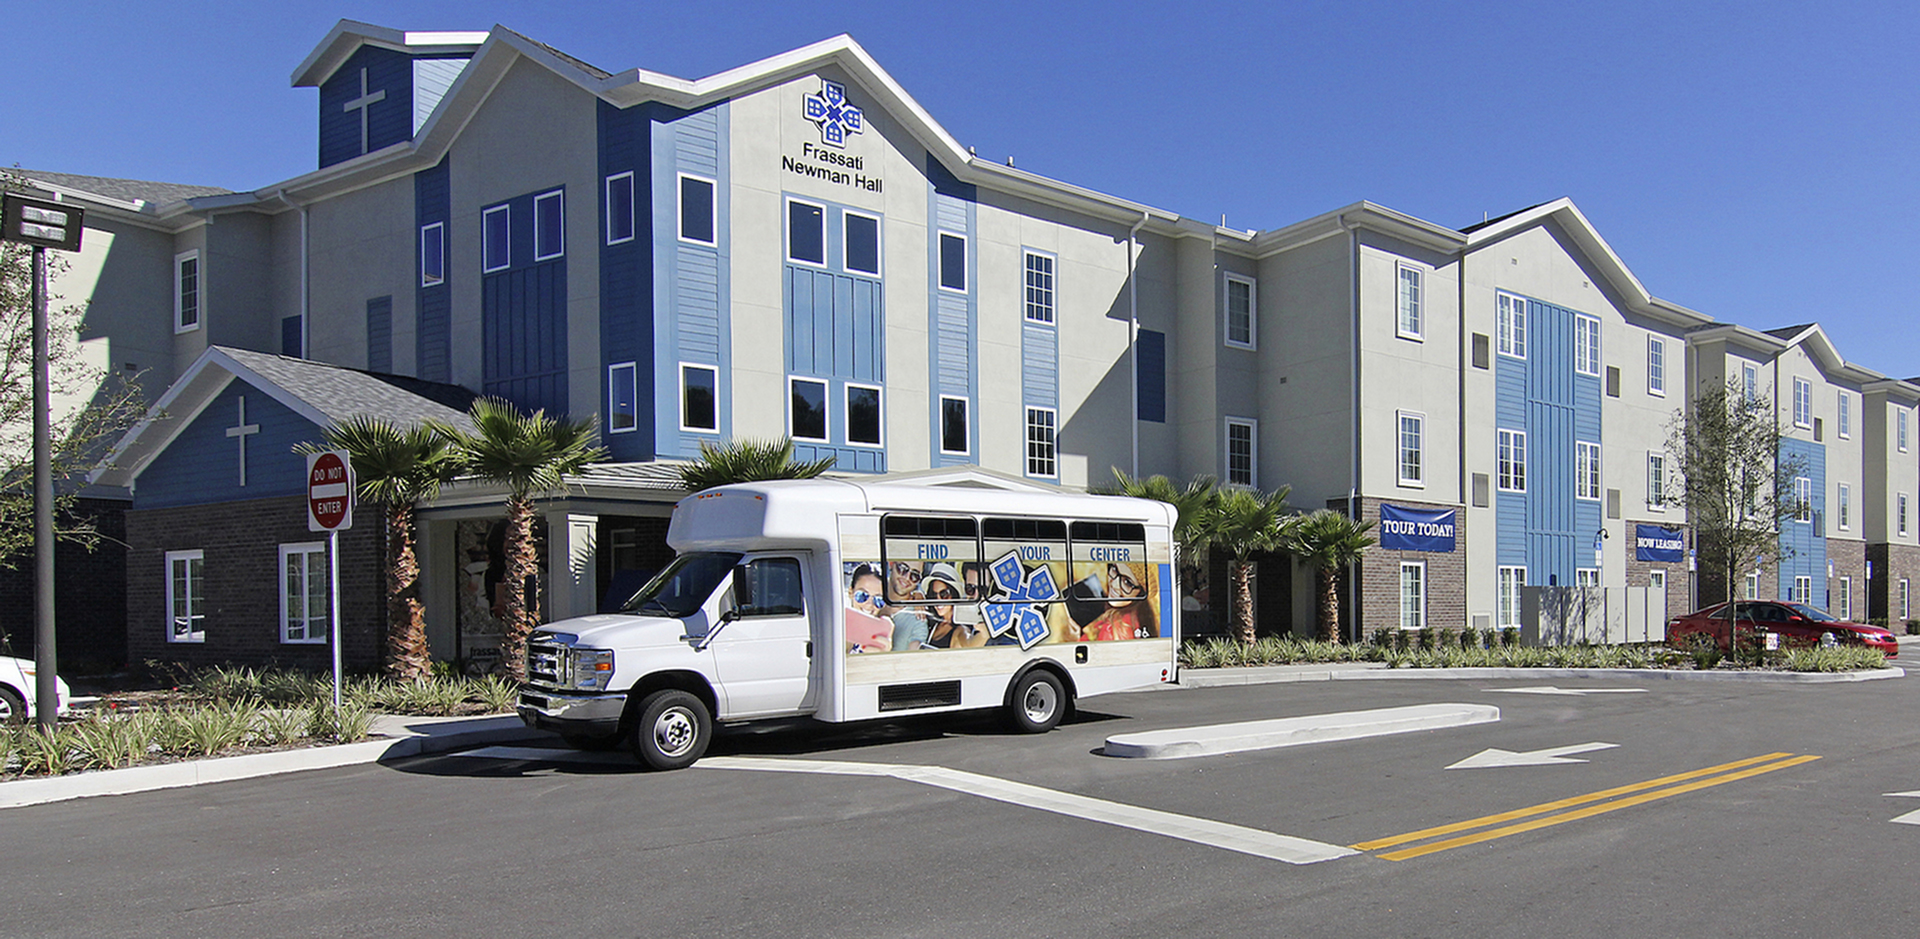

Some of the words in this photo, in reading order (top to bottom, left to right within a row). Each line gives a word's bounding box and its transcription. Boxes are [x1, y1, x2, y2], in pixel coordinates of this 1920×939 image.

[803, 142, 863, 170] Frassati
[782, 155, 850, 185] Newman
[855, 173, 883, 193] Hall
[314, 469, 325, 481] DO
[328, 466, 342, 479] NOT
[318, 501, 341, 514] ENTER
[1383, 520, 1415, 535] TOUR
[1417, 523, 1453, 537] TODAY!
[1637, 537, 1654, 548] NOW
[917, 543, 948, 559] FIND
[1020, 546, 1050, 560] YOUR
[1090, 547, 1130, 562] CENTER
